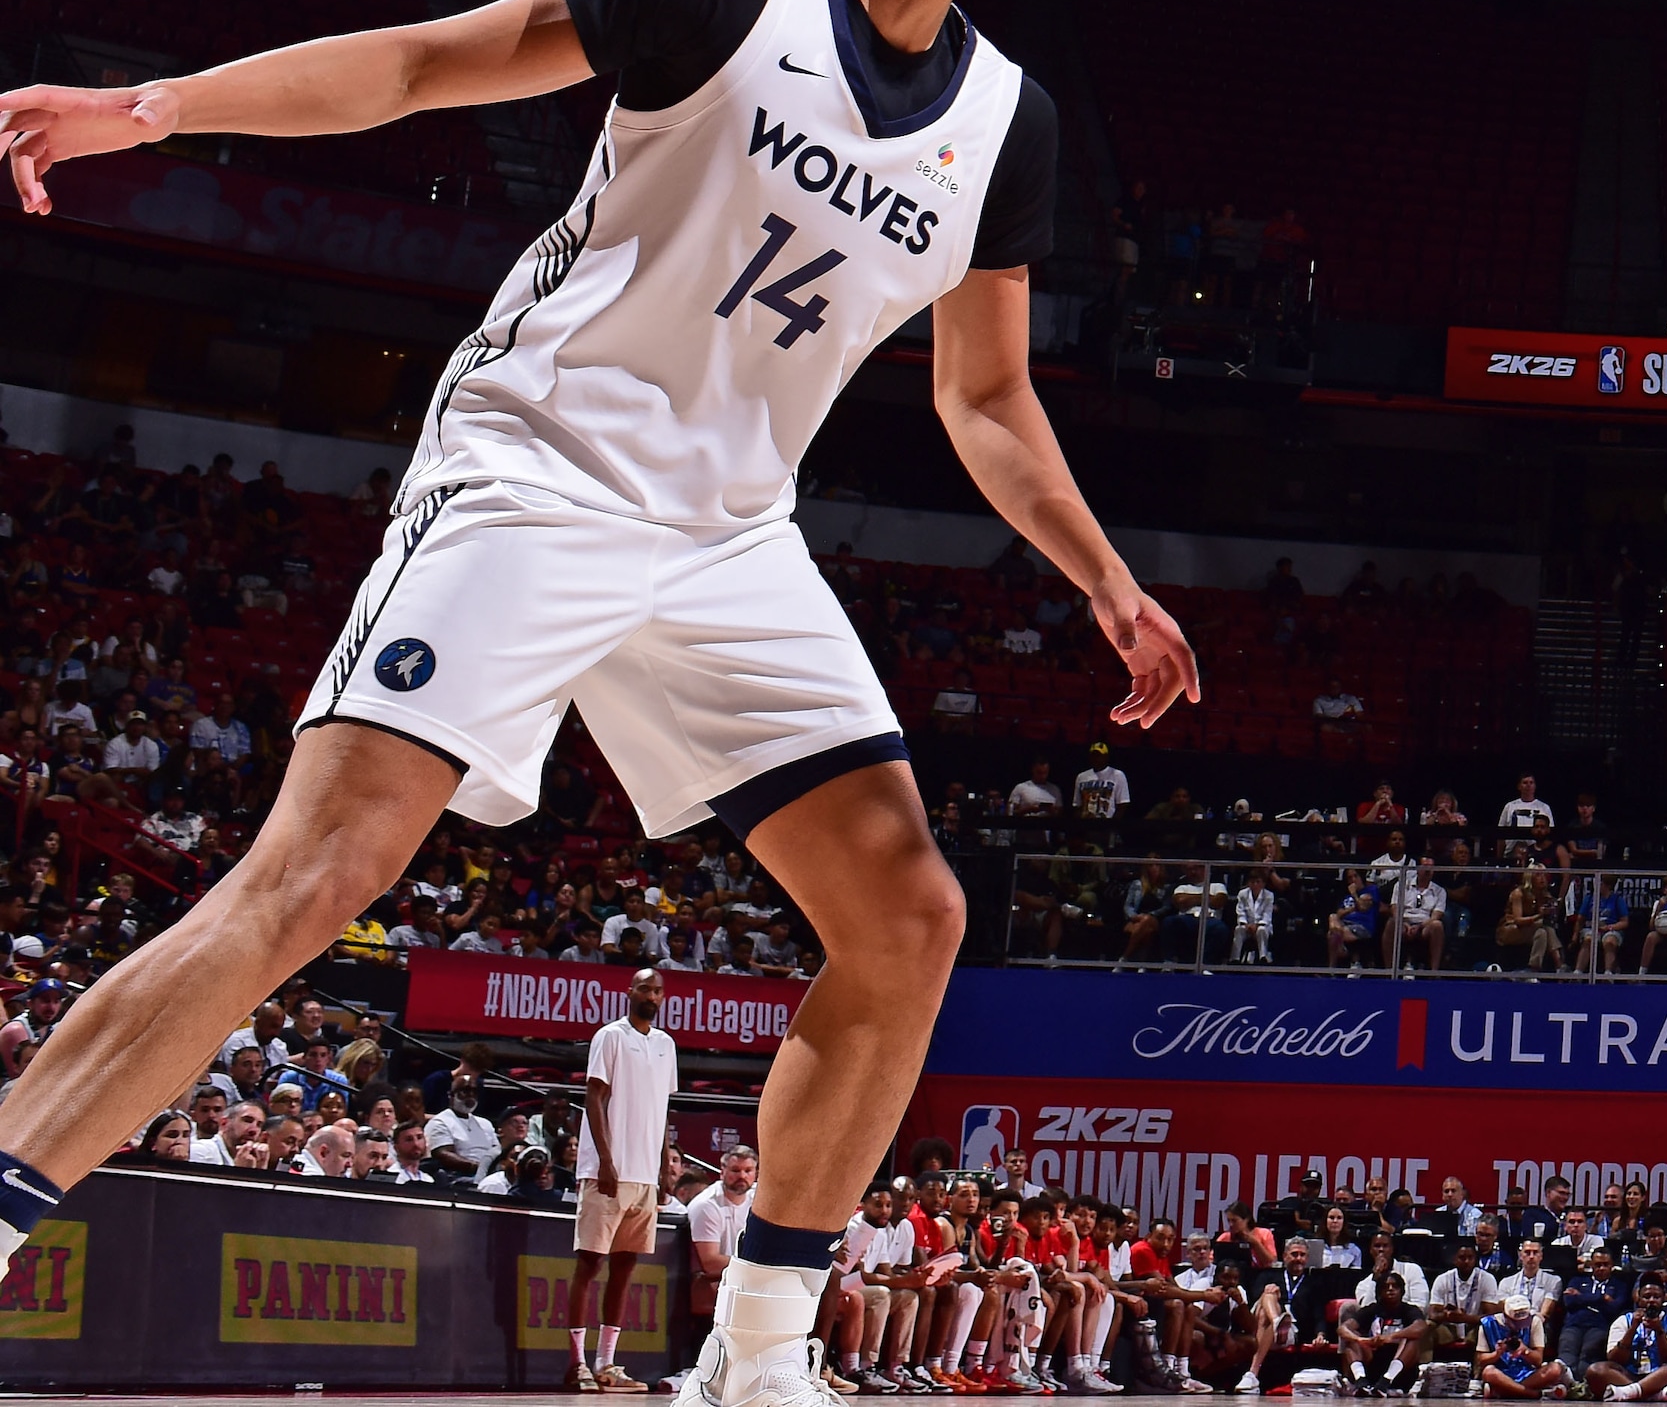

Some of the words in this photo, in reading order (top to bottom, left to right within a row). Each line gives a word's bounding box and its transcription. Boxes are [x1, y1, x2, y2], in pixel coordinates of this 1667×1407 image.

[748, 106, 941, 255] WOLVES
[915, 157, 960, 196] sezzle
[257, 188, 432, 272] State
[713, 212, 848, 351] 14
[1157, 360, 1171, 377] 8
[1487, 353, 1577, 377] 2K26
[484, 971, 787, 1043] #NBA2KSuerLeague
[1132, 1003, 1384, 1058] Michelob
[1033, 1107, 1173, 1143] 2K26
[233, 1257, 407, 1323] PANINI
